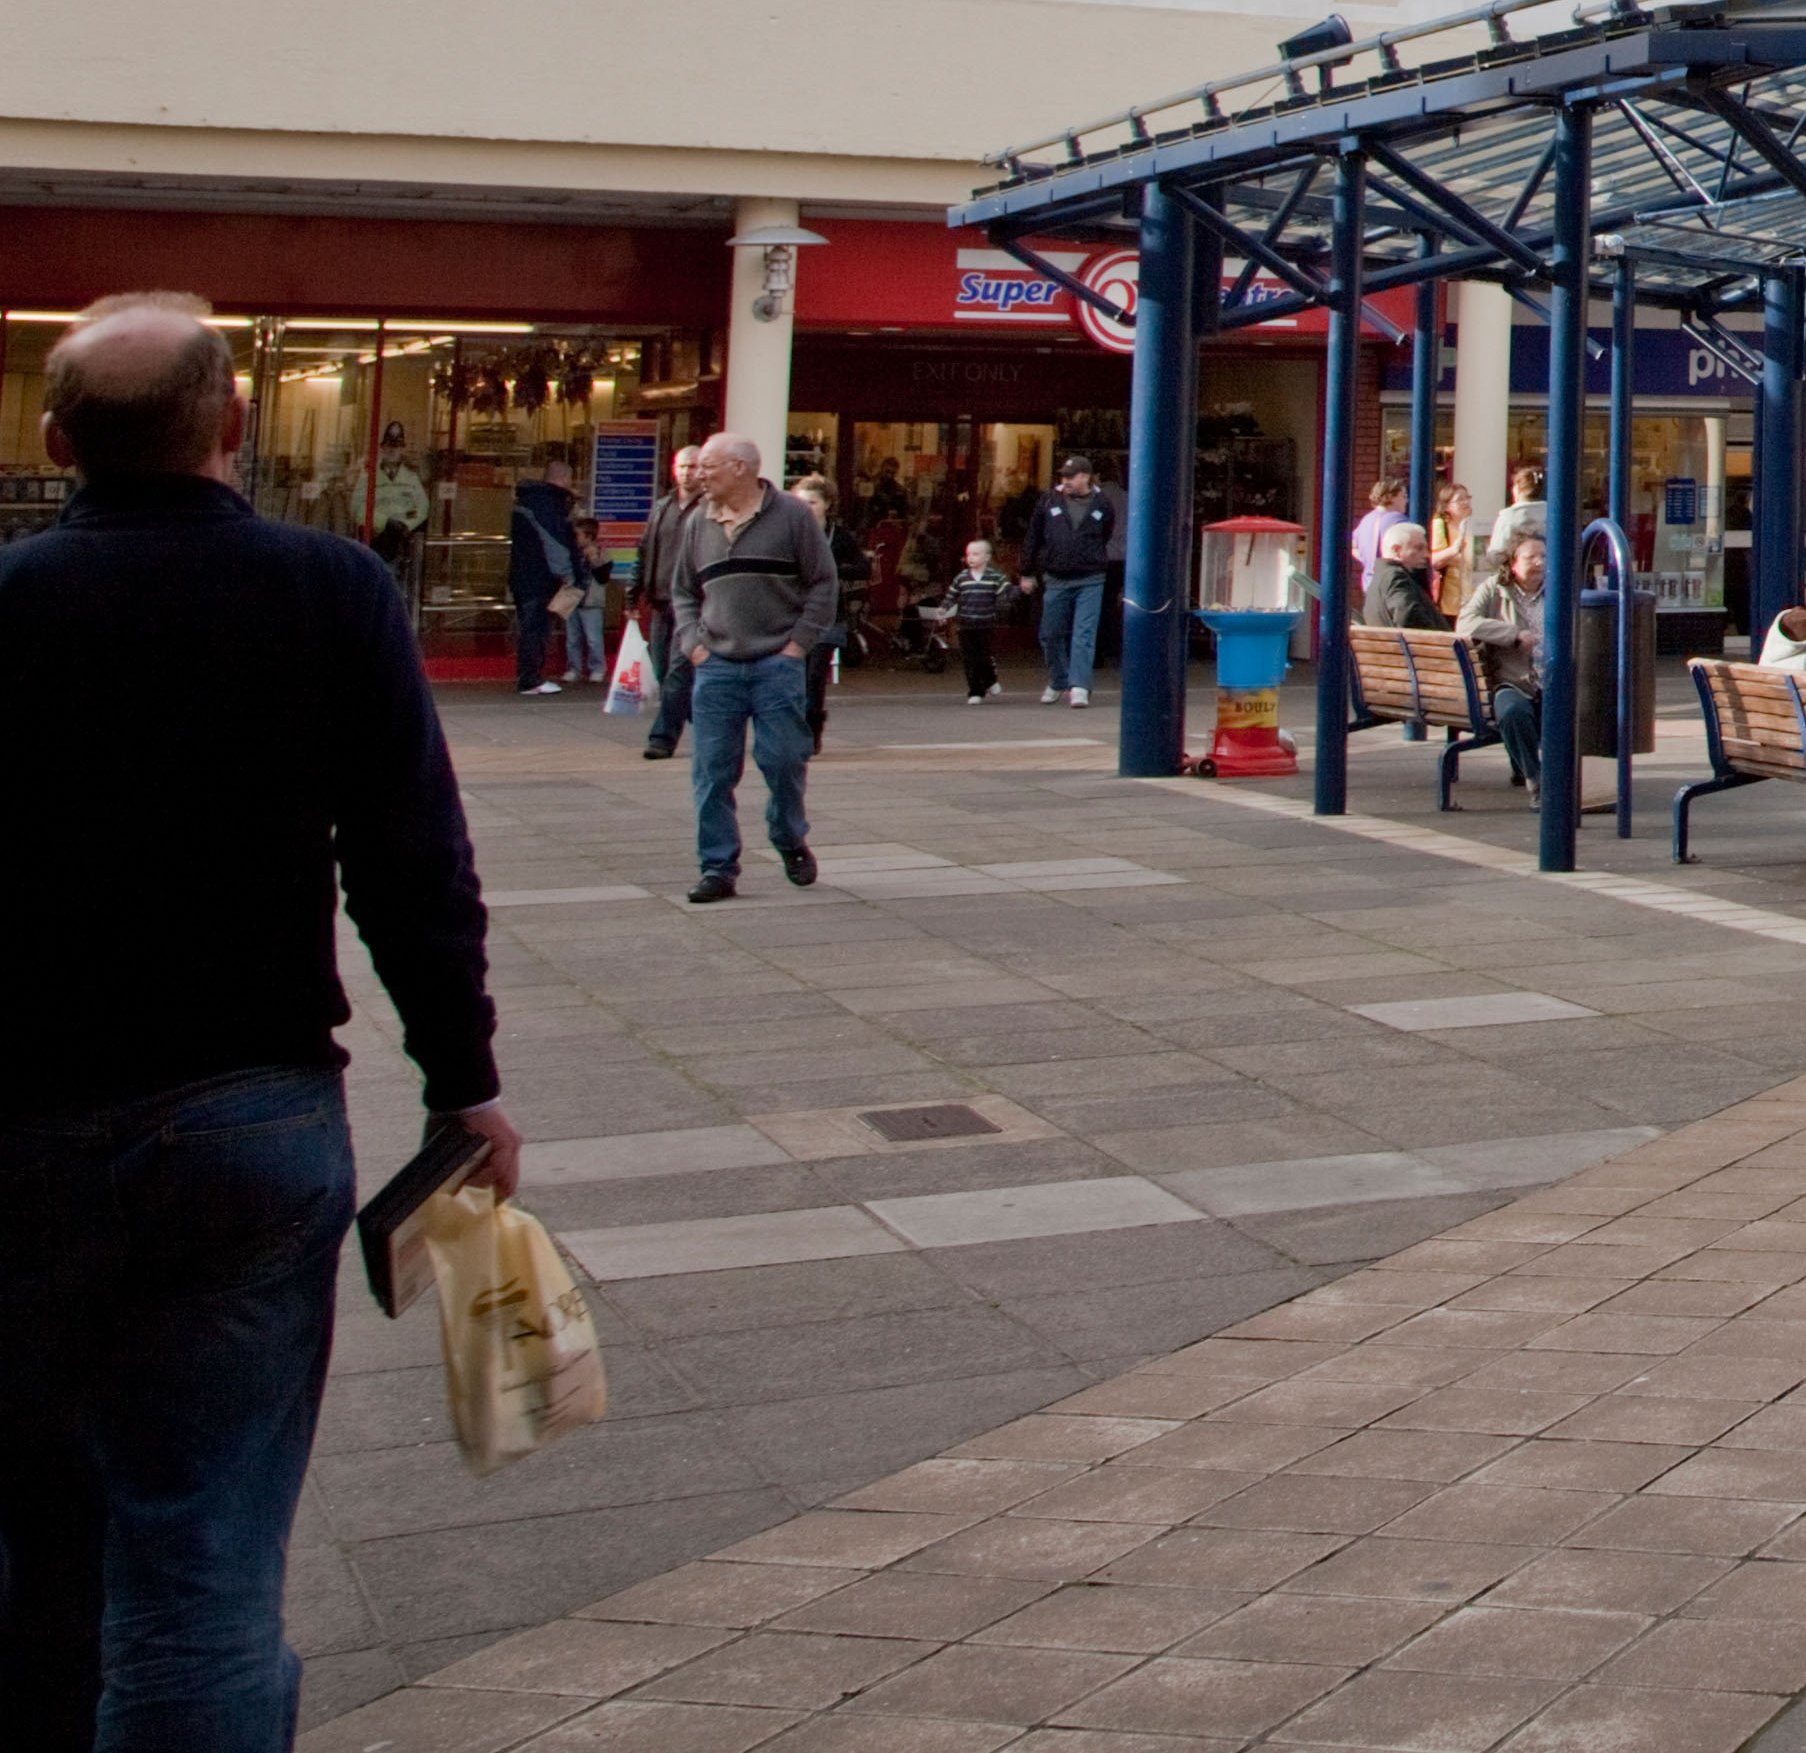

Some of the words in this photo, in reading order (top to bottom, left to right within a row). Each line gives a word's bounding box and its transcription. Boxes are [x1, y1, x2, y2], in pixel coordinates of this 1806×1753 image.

[956, 272, 1062, 311] Super
[911, 361, 961, 382] EXIT
[964, 361, 1024, 383] ONLY
